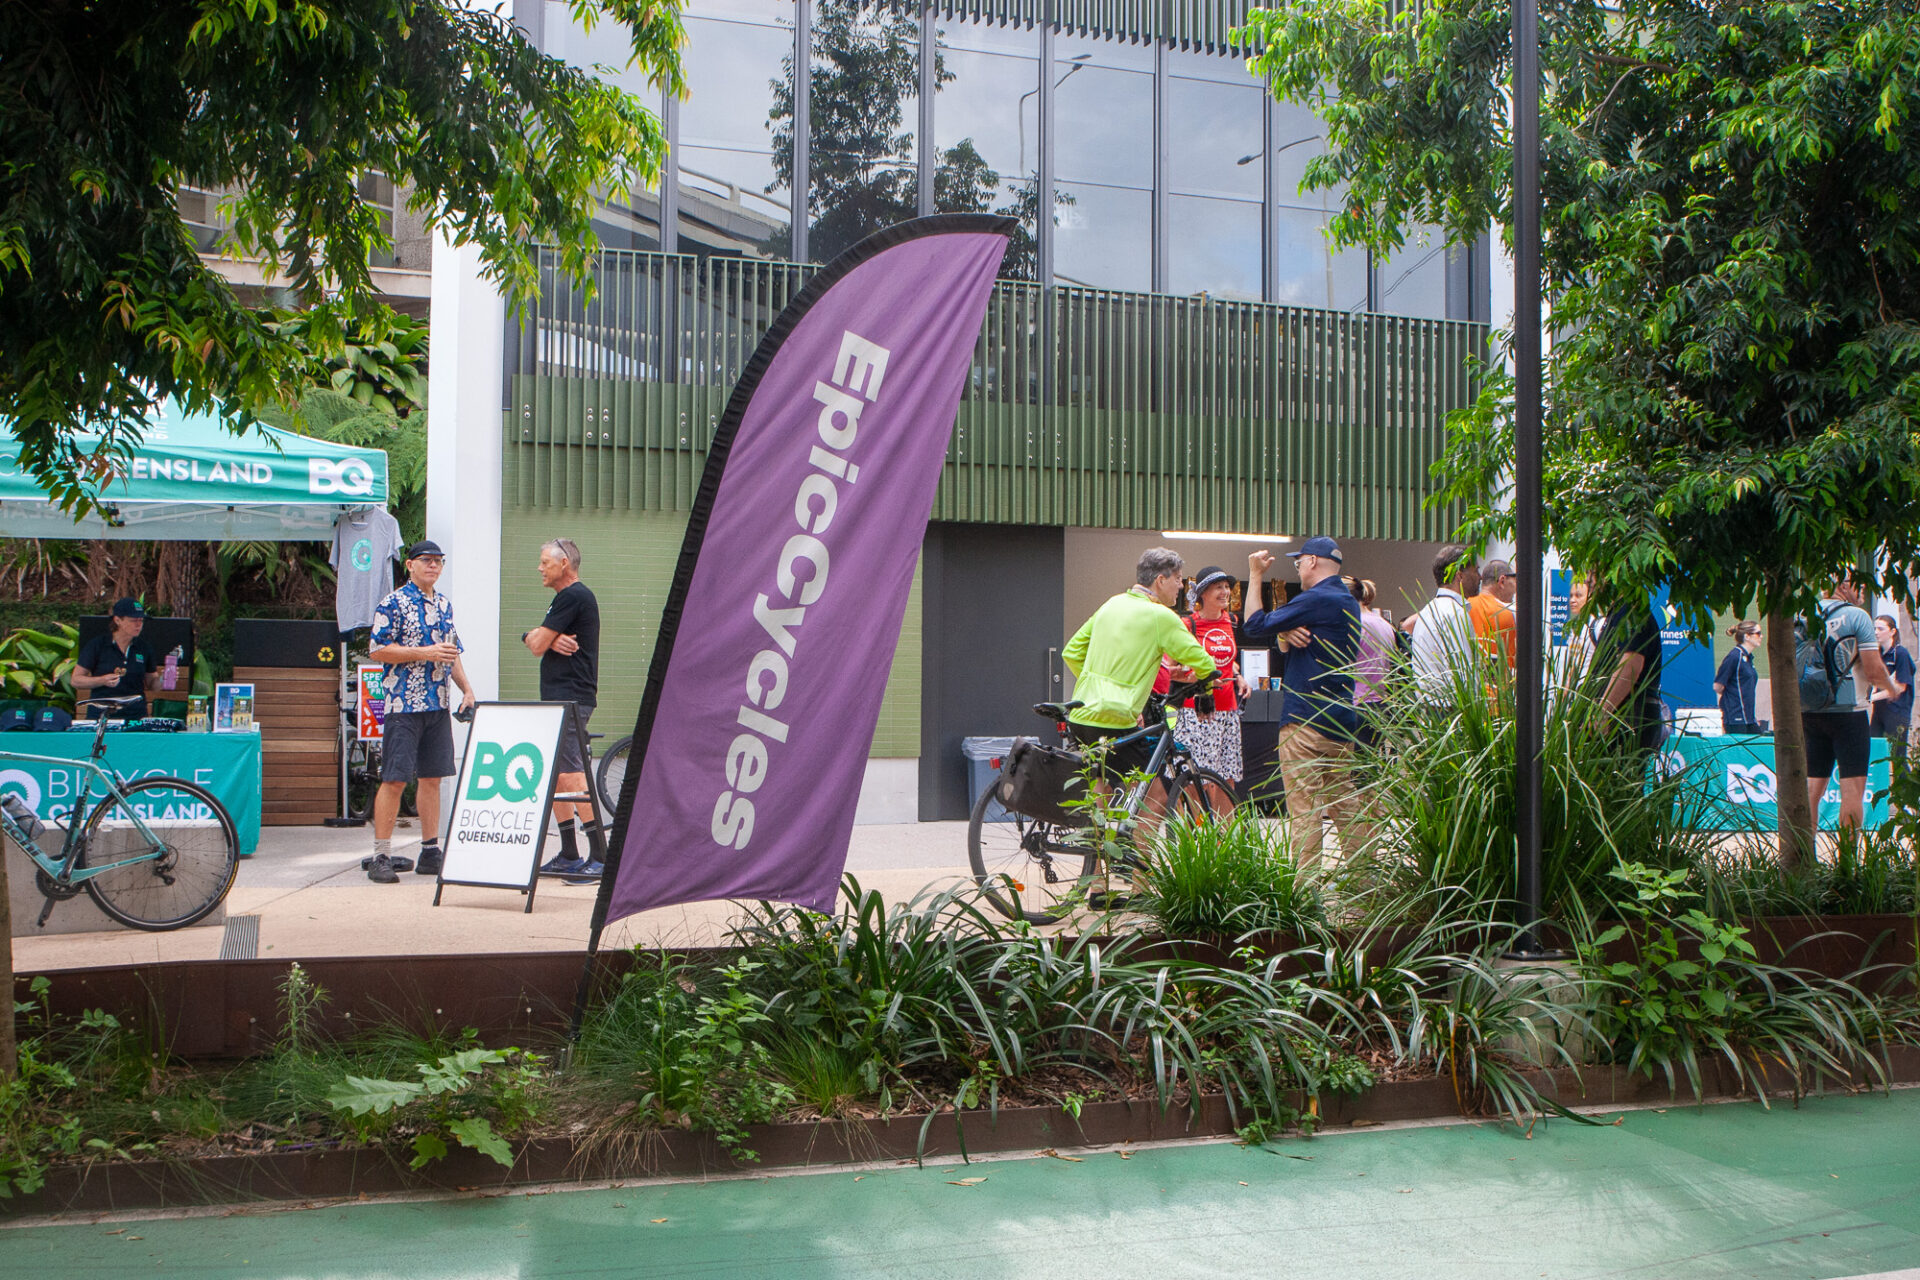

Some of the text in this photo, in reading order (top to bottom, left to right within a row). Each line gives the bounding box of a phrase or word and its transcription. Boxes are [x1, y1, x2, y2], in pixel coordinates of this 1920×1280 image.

[309, 457, 374, 496] BQ
[362, 672, 383, 681] SPE
[465, 741, 545, 803] BQ
[1727, 763, 1778, 804] BQ
[459, 808, 536, 831] BICYCLE
[457, 831, 531, 845] QUEENSLAND
